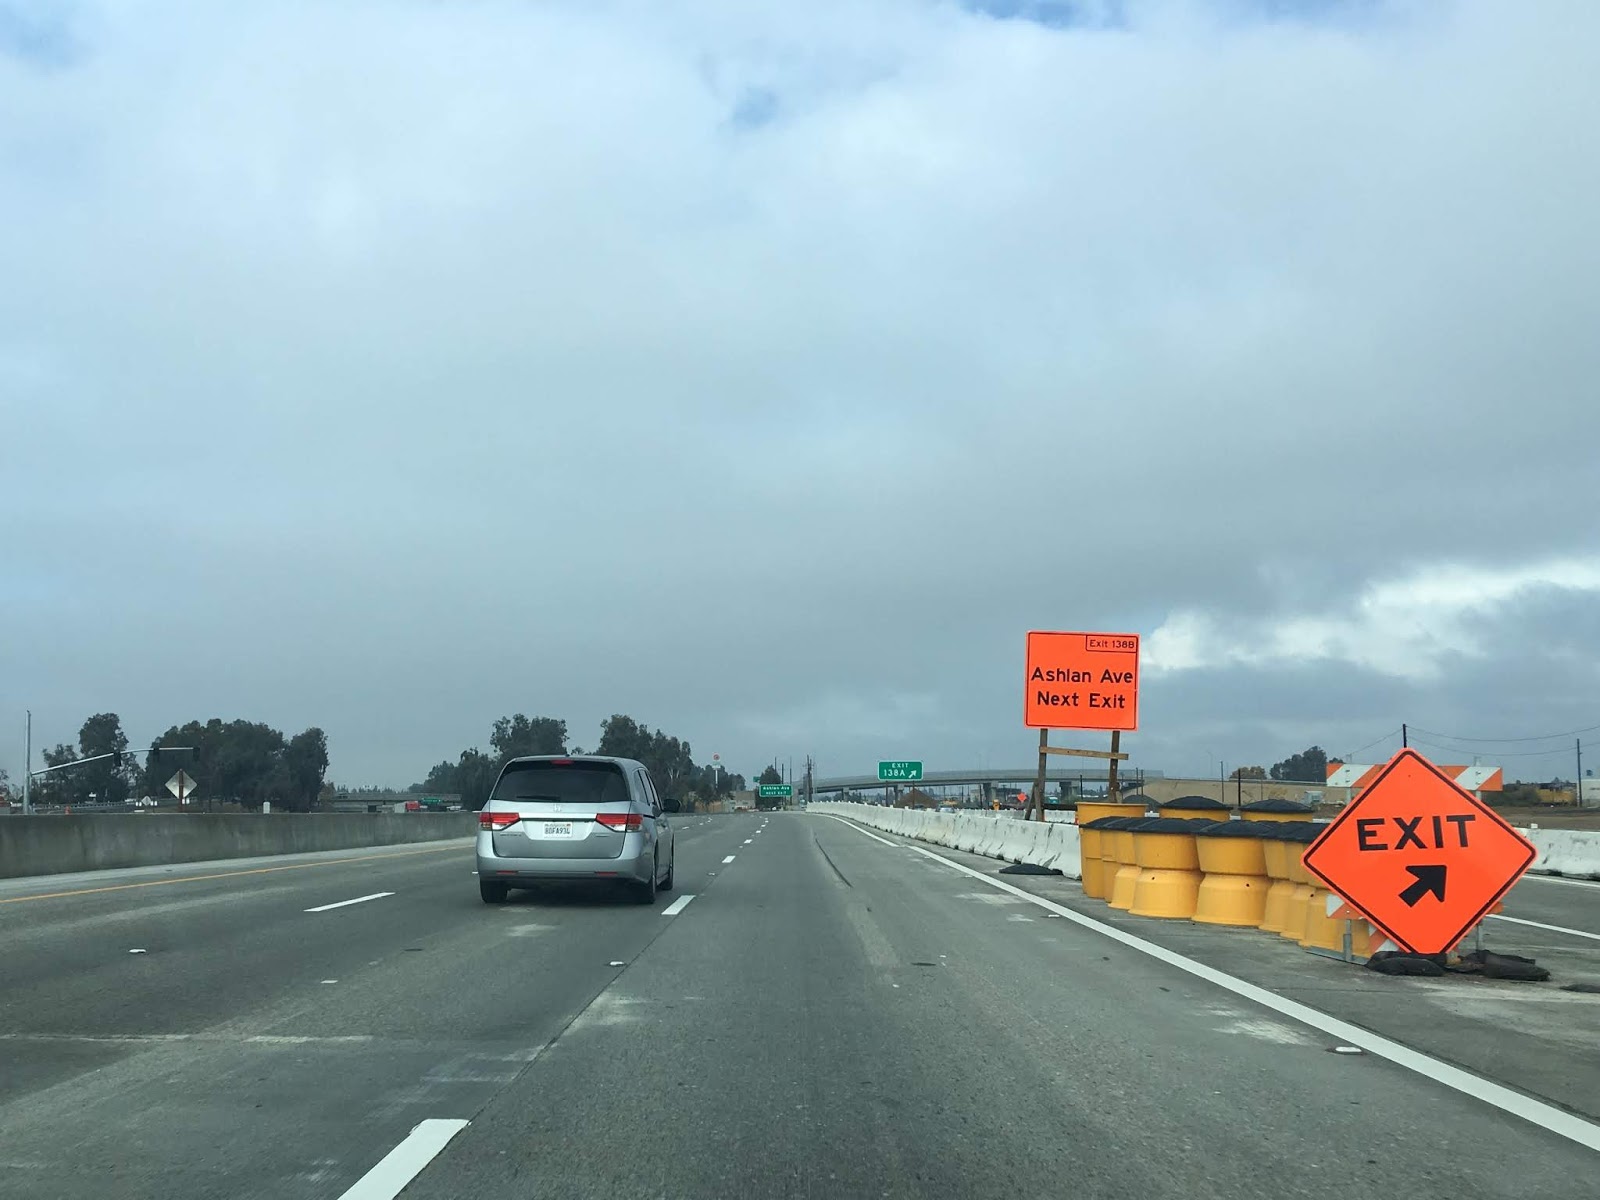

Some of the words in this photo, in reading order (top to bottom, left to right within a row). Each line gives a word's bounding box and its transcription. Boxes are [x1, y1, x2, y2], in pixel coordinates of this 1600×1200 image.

[1089, 639, 1108, 648] Exit
[1112, 640, 1135, 649] 138B
[1031, 667, 1092, 683] Ashlan
[1100, 669, 1133, 684] Ave
[1037, 691, 1079, 706] Next
[1089, 693, 1125, 708] Exit
[884, 769, 905, 777] 138A
[1356, 814, 1476, 851] EXIT
